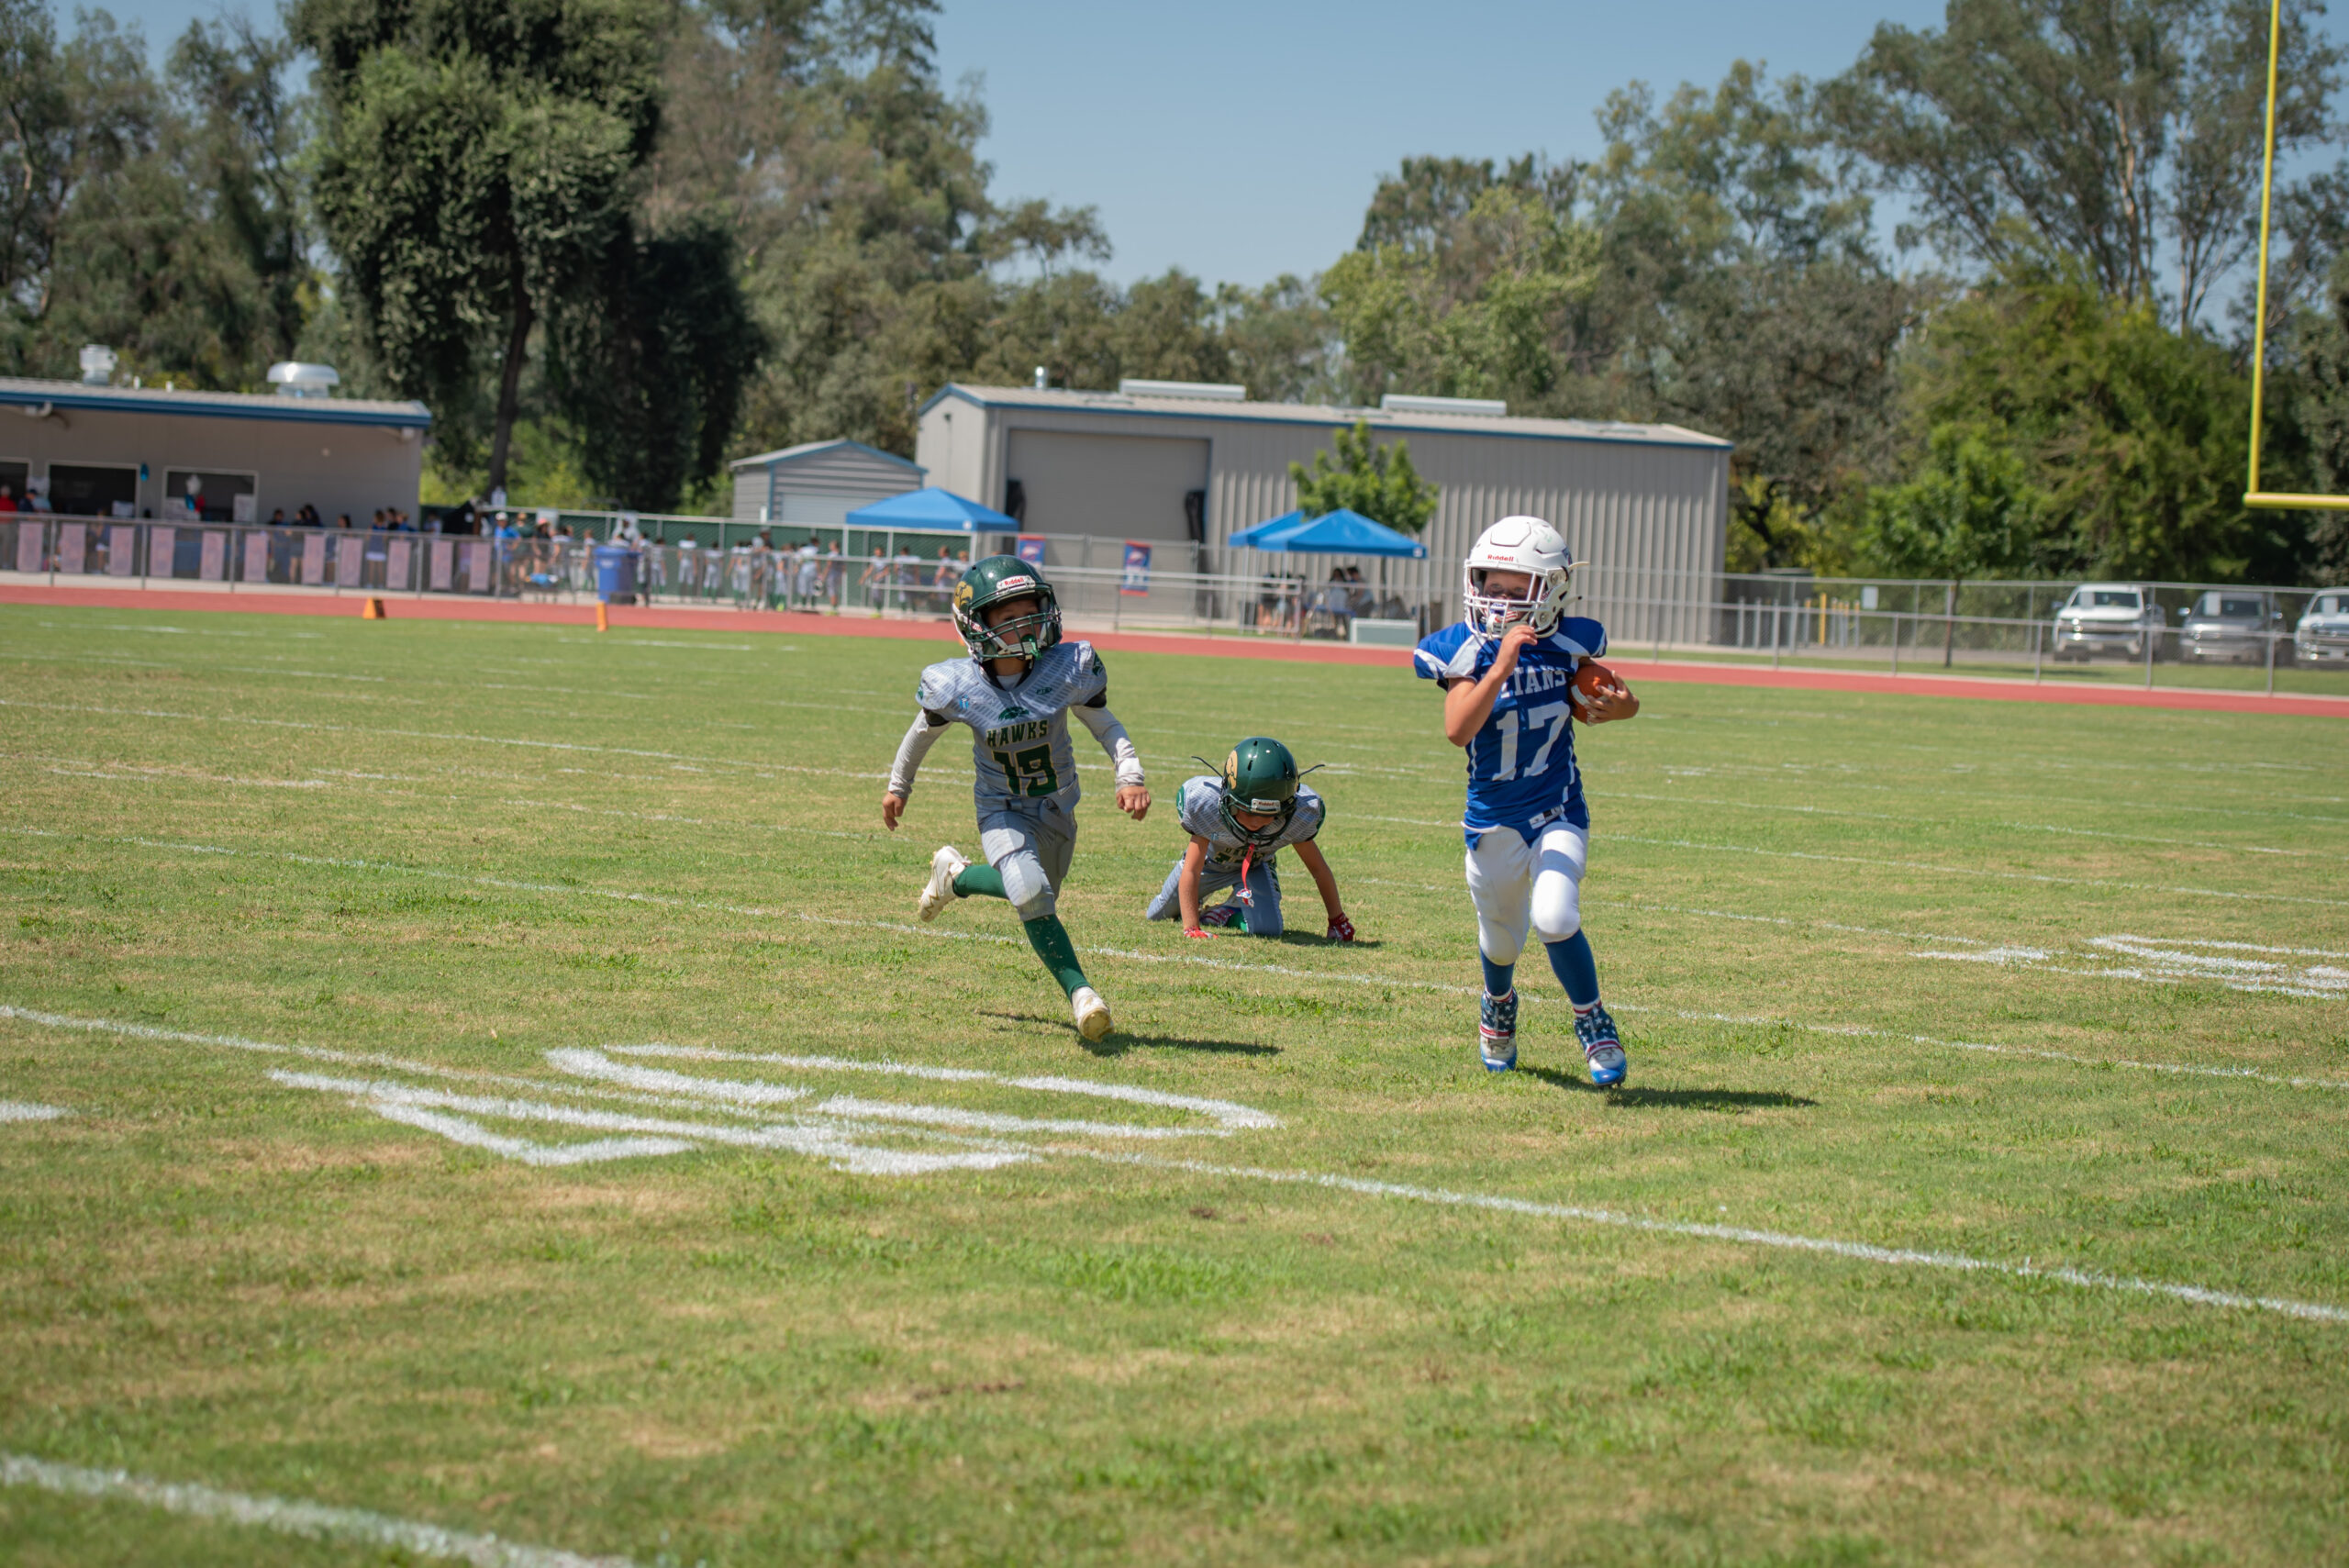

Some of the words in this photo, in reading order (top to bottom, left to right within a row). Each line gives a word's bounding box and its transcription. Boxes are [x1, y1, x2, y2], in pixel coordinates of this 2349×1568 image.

[1487, 554, 1515, 562] Riddell
[1004, 577, 1025, 587] Riddell
[1497, 665, 1567, 698] TANS
[986, 719, 1049, 748] HAWKS
[1491, 699, 1572, 782] 17
[992, 741, 1059, 797] 19
